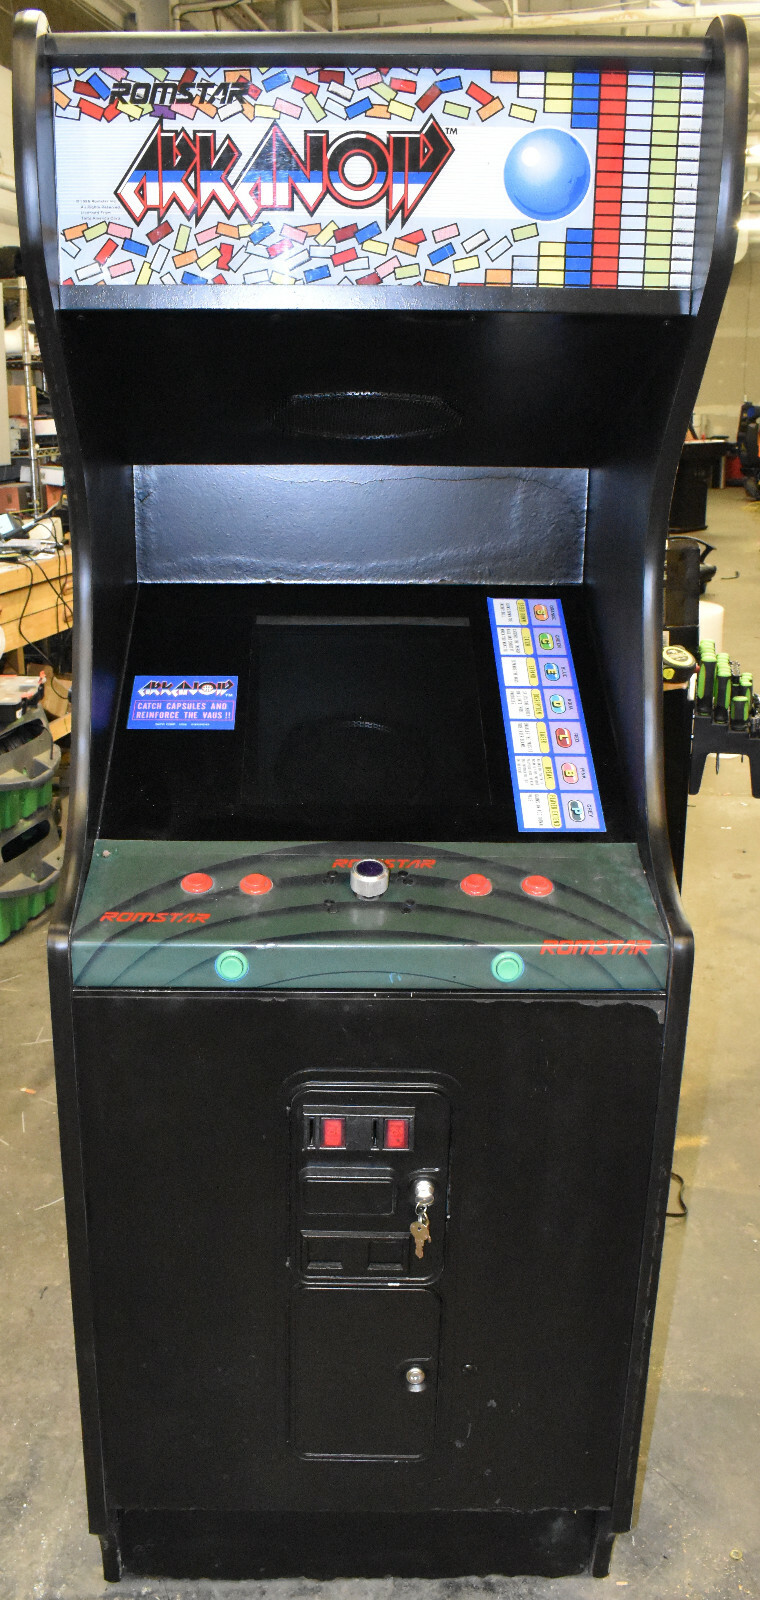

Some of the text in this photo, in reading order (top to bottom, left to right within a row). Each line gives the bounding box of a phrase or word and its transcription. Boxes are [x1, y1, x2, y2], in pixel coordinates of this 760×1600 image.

[109, 82, 249, 105] ROMSTAR
[114, 115, 455, 230] ARKANOID
[137, 679, 234, 697] ARKANOID
[137, 702, 227, 710] CATCH CAPSULES AND
[136, 711, 179, 719] REINFORCE
[184, 711, 198, 719] THE
[202, 711, 222, 719] VAUS
[332, 858, 436, 869] ROSTAR
[100, 911, 211, 924] ROMSTAR
[539, 939, 652, 955] ROMSTAR
